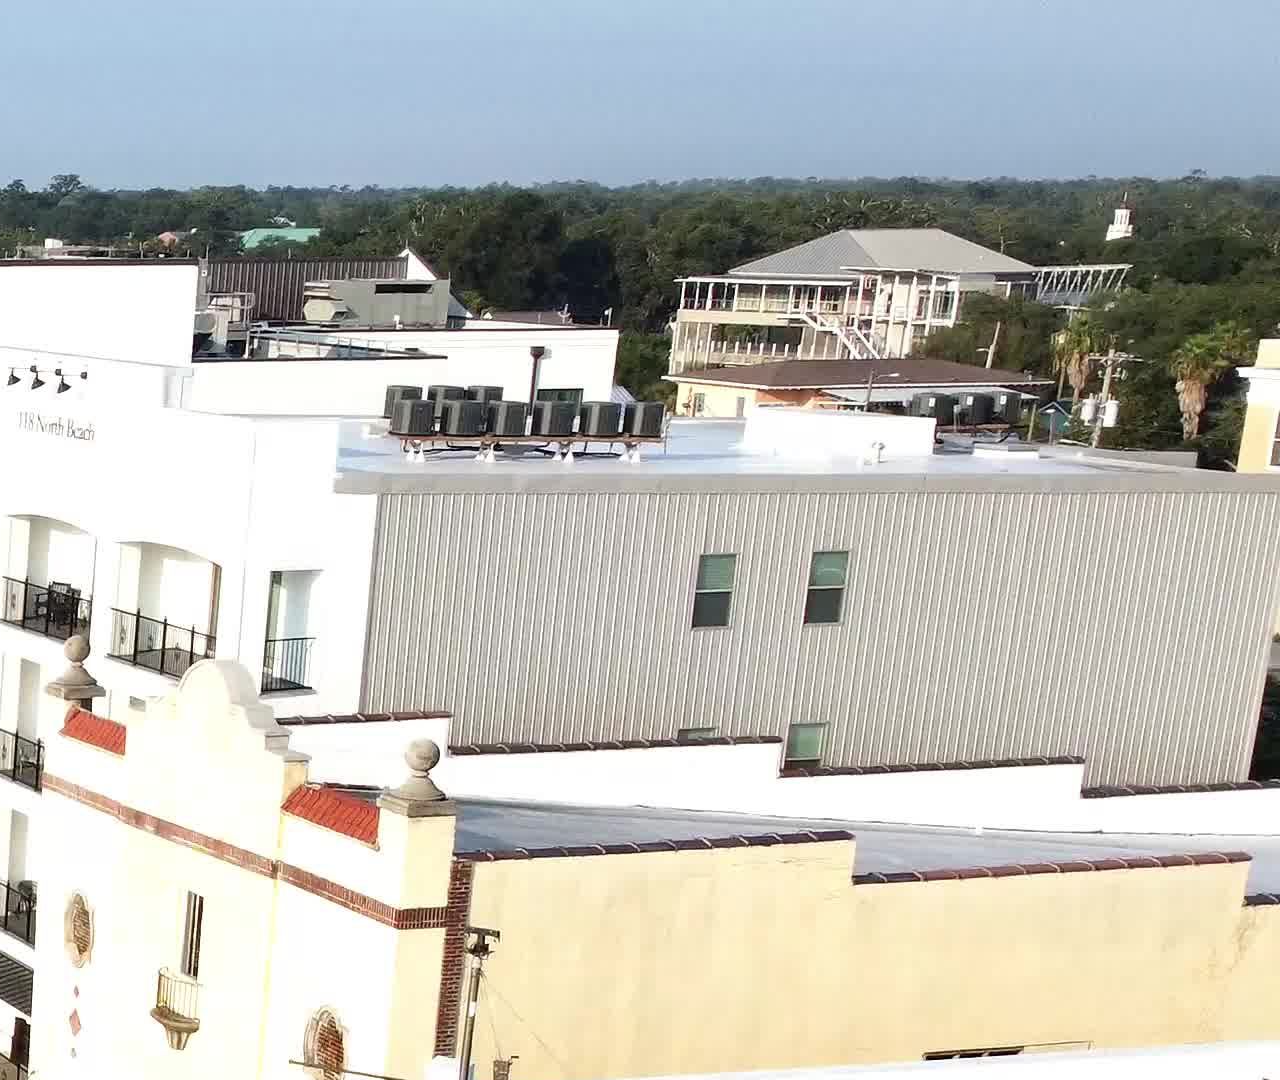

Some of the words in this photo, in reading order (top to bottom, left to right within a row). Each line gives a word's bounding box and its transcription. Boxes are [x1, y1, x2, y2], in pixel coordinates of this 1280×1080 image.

[18, 411, 35, 431] 118
[35, 413, 64, 437] North
[66, 418, 96, 441] Beach
